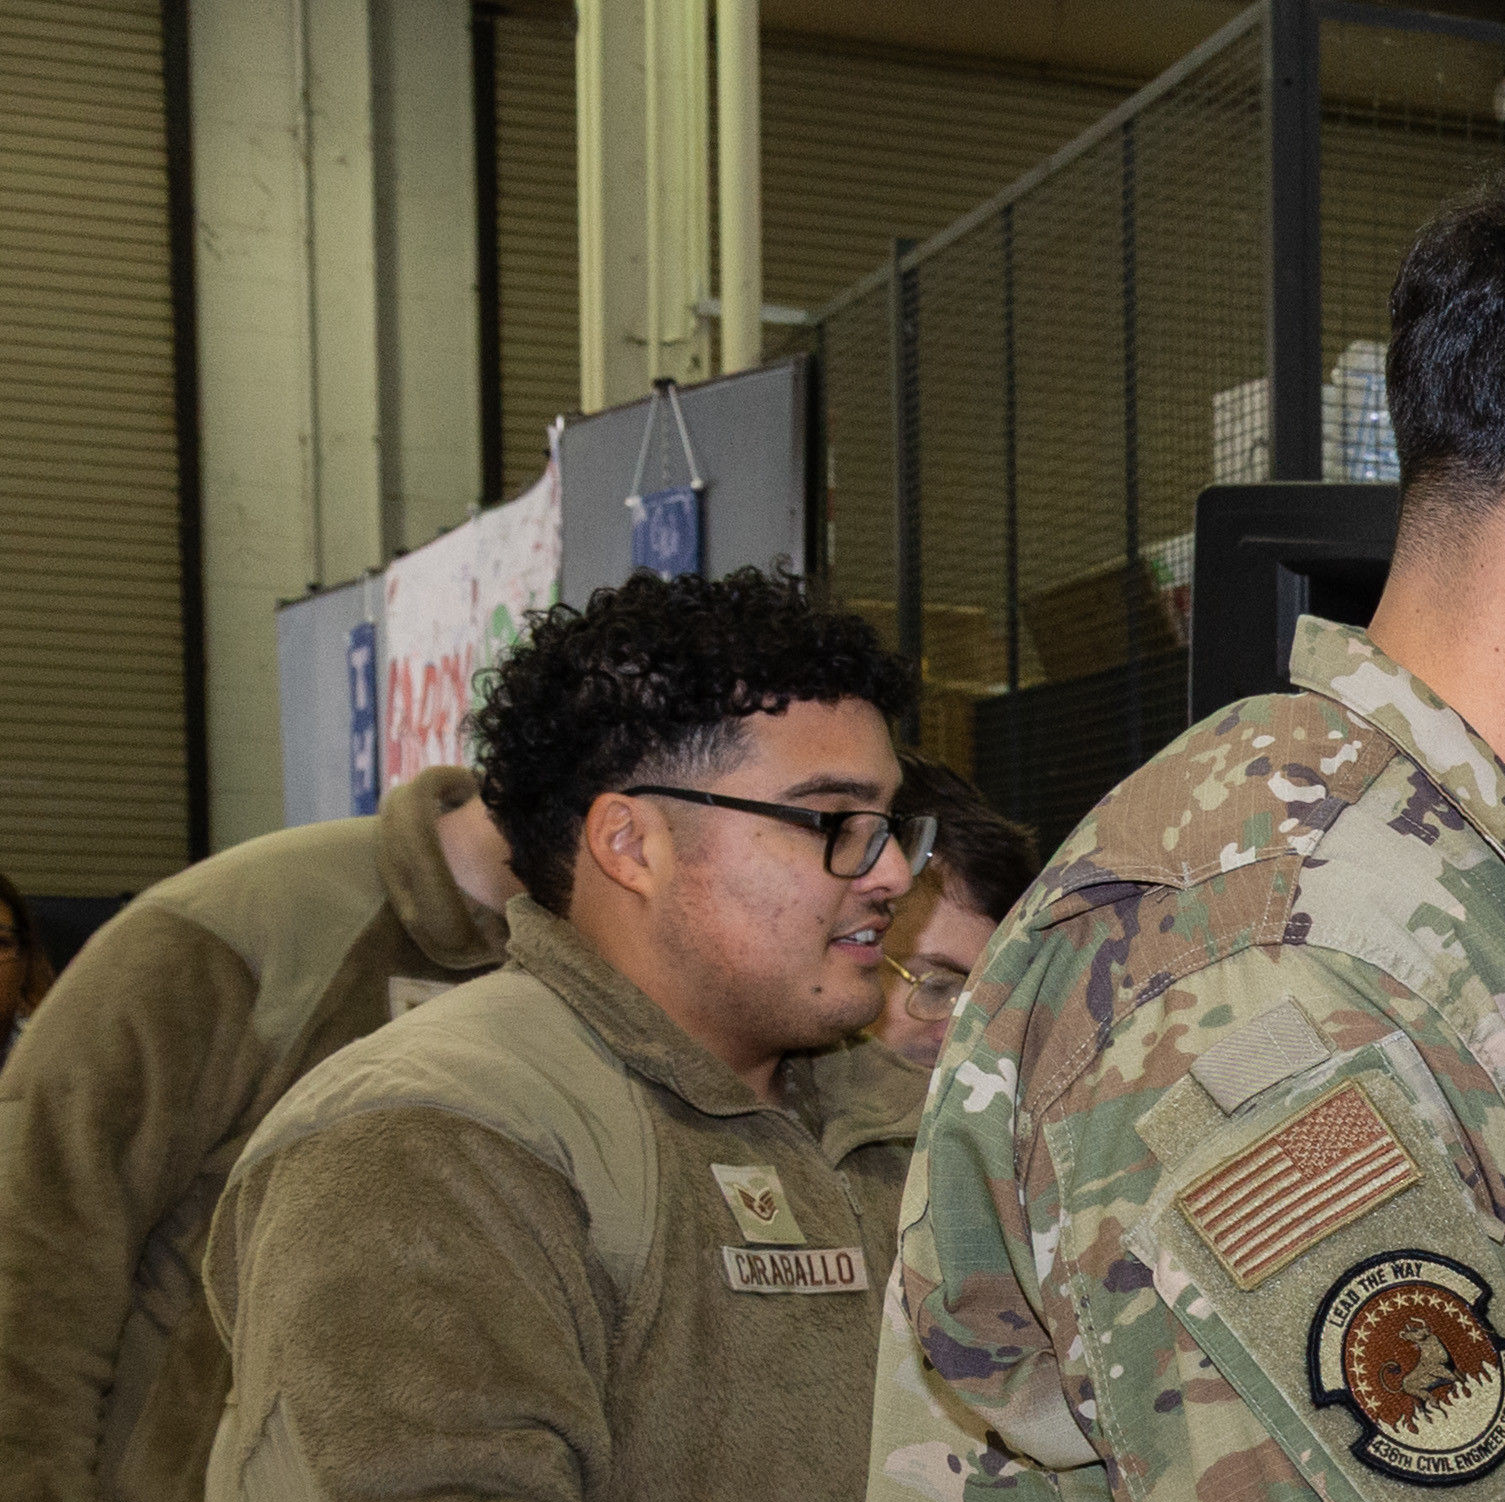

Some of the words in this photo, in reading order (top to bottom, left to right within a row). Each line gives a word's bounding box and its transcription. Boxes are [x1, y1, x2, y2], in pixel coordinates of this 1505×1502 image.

[734, 1252, 855, 1287] CARABALLO
[1328, 1289, 1361, 1328] LEAD
[1358, 1268, 1389, 1293] THE
[1392, 1261, 1423, 1280] WAY
[1371, 1439, 1413, 1468] 436TH
[1416, 1456, 1454, 1473] CIVIL
